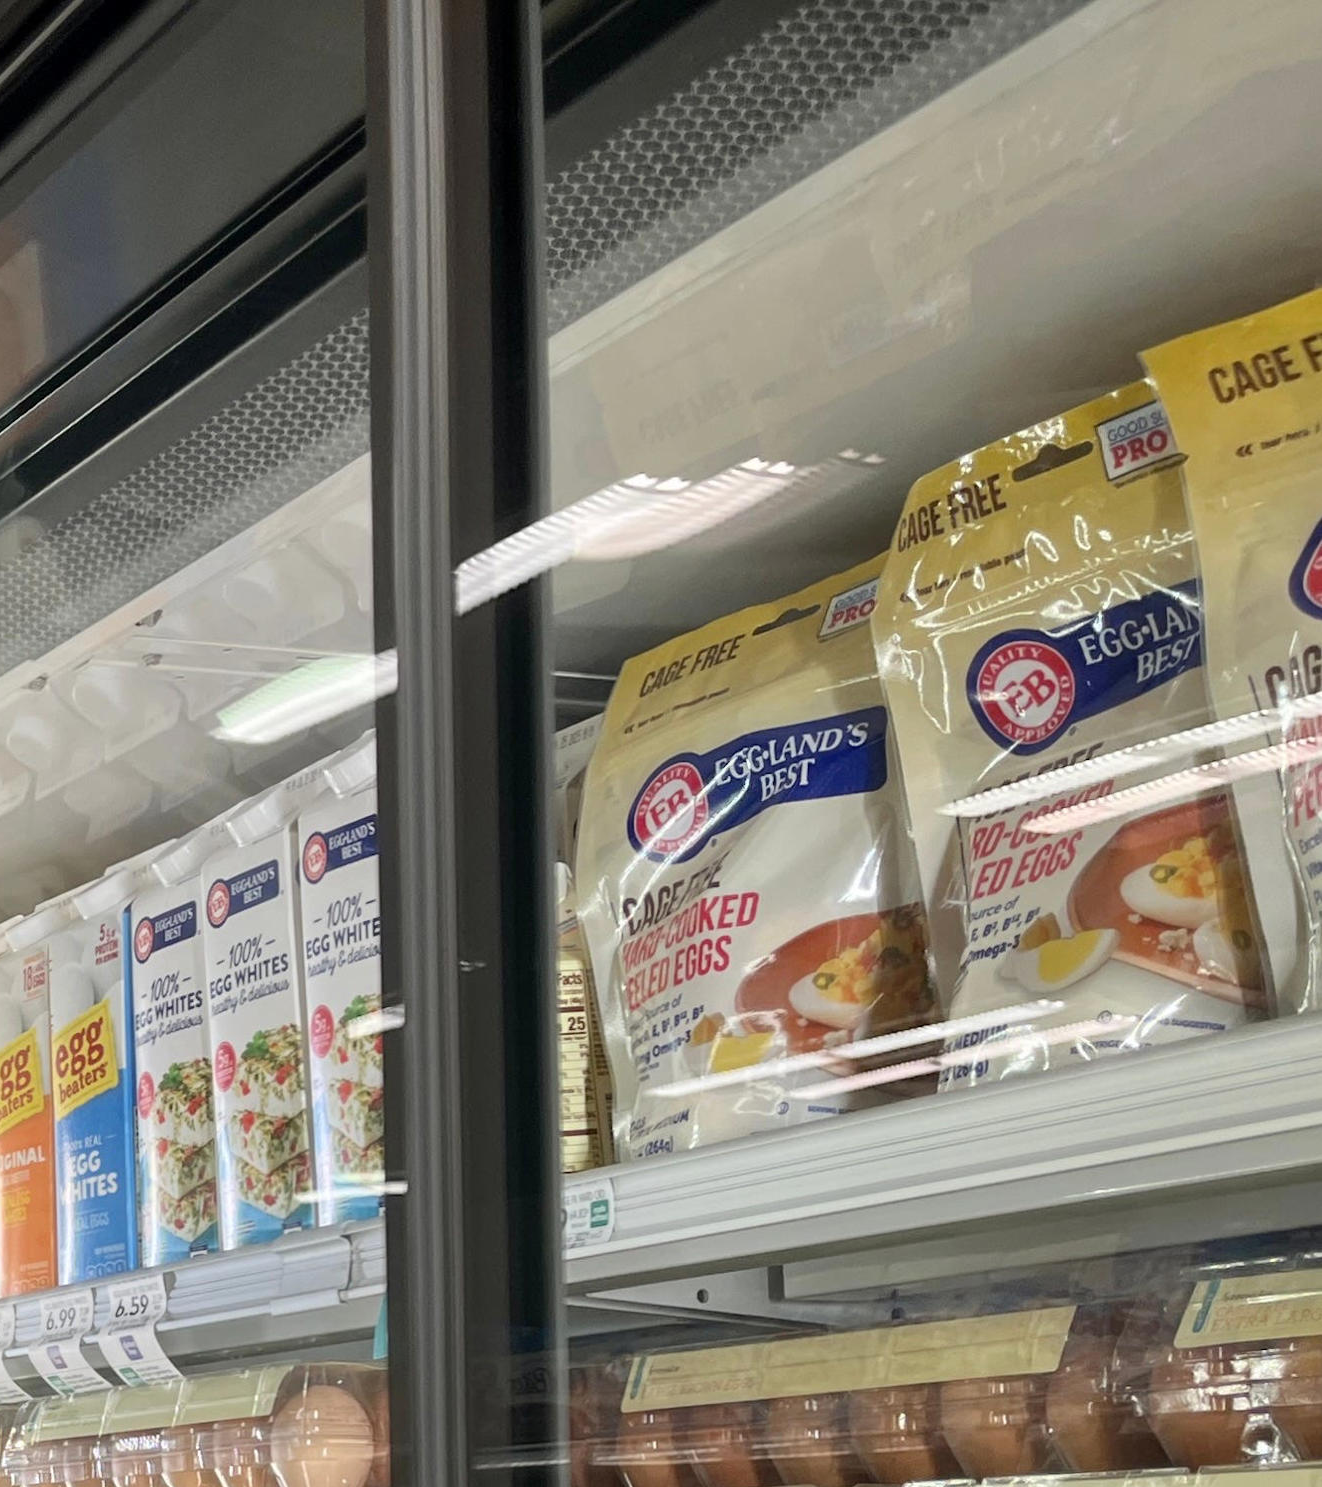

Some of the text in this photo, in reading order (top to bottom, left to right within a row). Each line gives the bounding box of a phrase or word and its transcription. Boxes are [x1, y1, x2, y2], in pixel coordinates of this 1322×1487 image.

[1209, 345, 1301, 404] CAGE
[1107, 418, 1148, 442] GOOD
[1112, 430, 1169, 470] PRO
[898, 473, 1007, 553] CAGE FREE
[828, 598, 877, 629] PRO
[639, 634, 746, 698] CAGE FREE
[1136, 632, 1199, 684] BEST
[1003, 674, 1072, 740] APPROVED
[760, 758, 816, 802] BEST
[341, 840, 363, 860] BEST
[1012, 830, 1083, 889] EGGS
[242, 884, 264, 905] BEST
[326, 892, 363, 927] 100%
[622, 880, 685, 937] CAGE
[969, 894, 1022, 922] ource of
[164, 924, 183, 943] BEST
[228, 933, 263, 969] 100%
[306, 916, 381, 960] EGG WHITE
[150, 970, 181, 1003] 100%
[209, 952, 289, 1000] EGG WHITES
[249, 978, 291, 1002] delicious
[625, 934, 732, 1013] EELED EGGS
[135, 989, 204, 1032] EGG WHITES
[670, 993, 683, 1009] of
[167, 1013, 204, 1035] delicious
[568, 1016, 586, 1032] 25
[56, 1016, 105, 1079] egg
[59, 1061, 109, 1104] beaters
[68, 1150, 103, 1178] EGG
[46, 1307, 77, 1331] 6.99
[115, 1294, 149, 1319] 6.59
